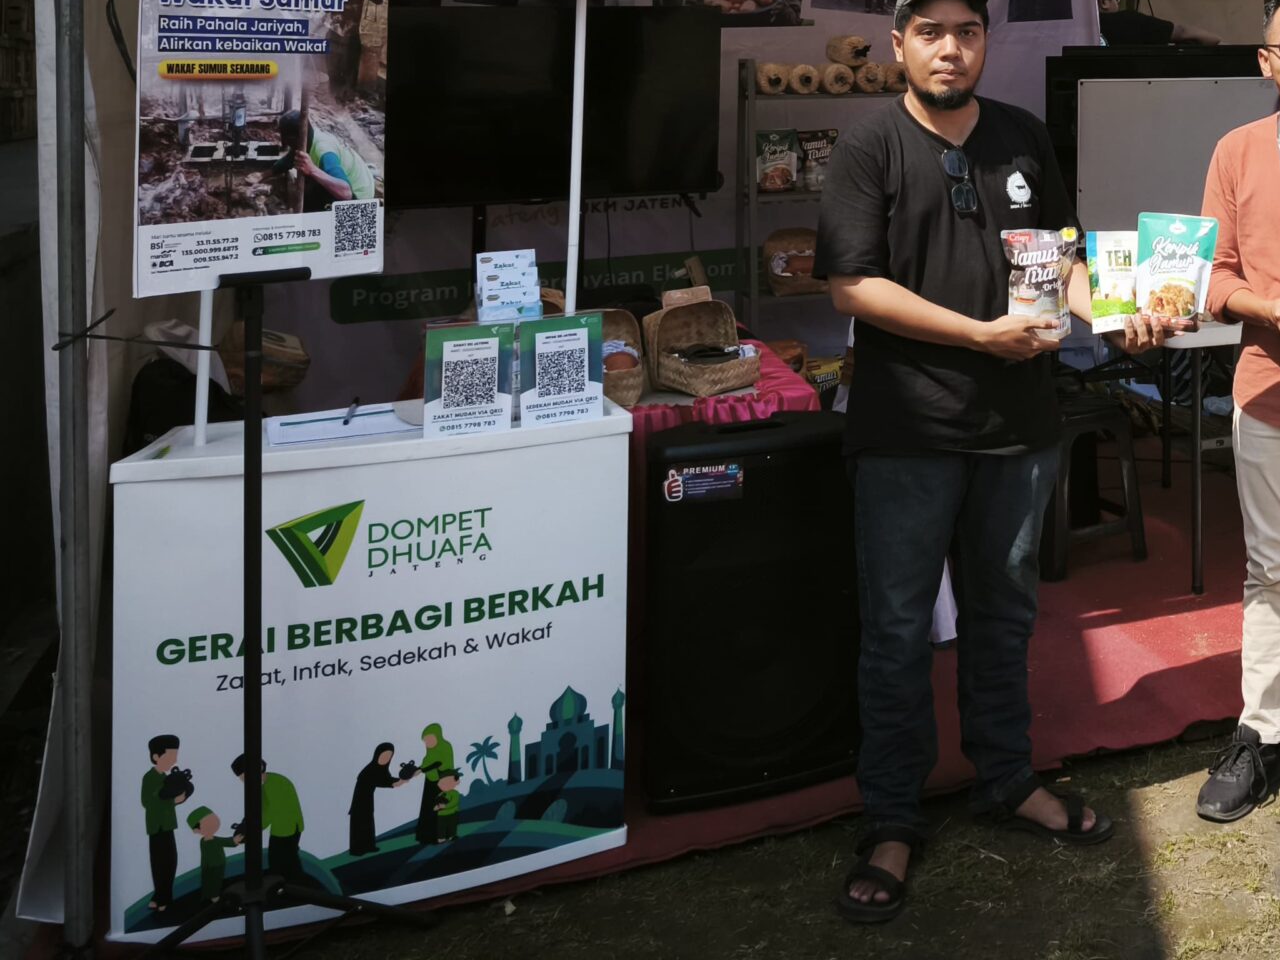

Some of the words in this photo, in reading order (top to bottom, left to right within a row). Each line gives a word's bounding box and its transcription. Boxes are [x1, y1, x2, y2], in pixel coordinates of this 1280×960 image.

[159, 16, 193, 30] Raih
[196, 18, 248, 31] Pahala
[250, 19, 306, 35] Jariyah,
[159, 38, 212, 51] Alirkan
[215, 39, 281, 51] kebaikan
[284, 40, 327, 53] Wakaf
[166, 63, 195, 74] WAKAF
[198, 63, 228, 74] SUMUR
[229, 63, 271, 74] SEKARANG
[263, 231, 284, 241] 0815
[286, 230, 306, 239] 7798
[307, 228, 321, 238] 783
[1010, 246, 1060, 266] Jamur
[1105, 249, 1132, 267] TEH
[1149, 253, 1194, 276] Jamur
[352, 284, 459, 314] Program
[683, 464, 726, 474] PREMIUM
[368, 507, 492, 544] DOMPET
[368, 532, 492, 569] DHUAFA
[368, 553, 487, 578] JATENG
[287, 601, 453, 651] BERBAGI
[463, 573, 605, 624] BERKAH
[215, 668, 287, 691] Zaat,
[293, 658, 353, 681] Infak,
[360, 642, 457, 671] Sedekah
[463, 638, 480, 654] &
[485, 621, 553, 650] Wakaf
